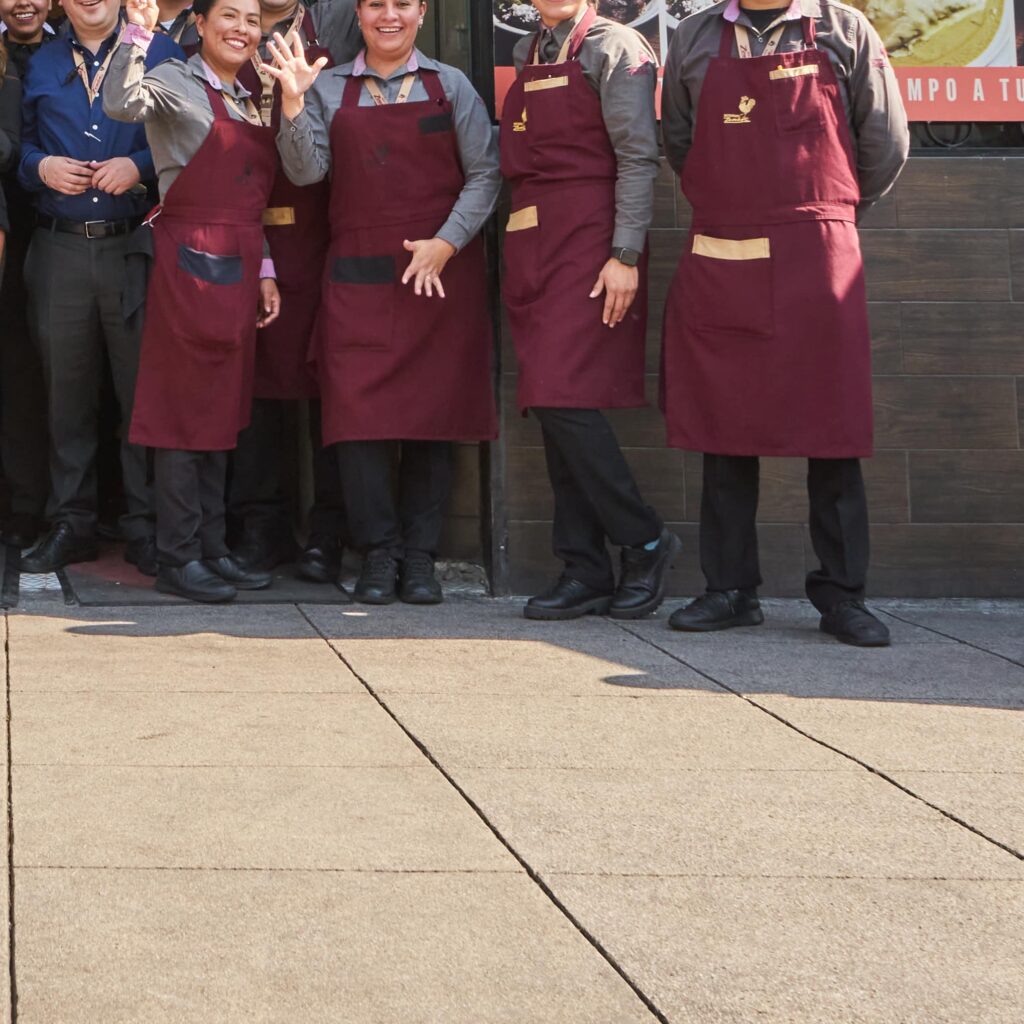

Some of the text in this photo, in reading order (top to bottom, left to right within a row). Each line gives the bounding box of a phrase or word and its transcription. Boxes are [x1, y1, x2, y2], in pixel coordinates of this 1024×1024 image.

[907, 77, 1024, 102] MPO A TU
